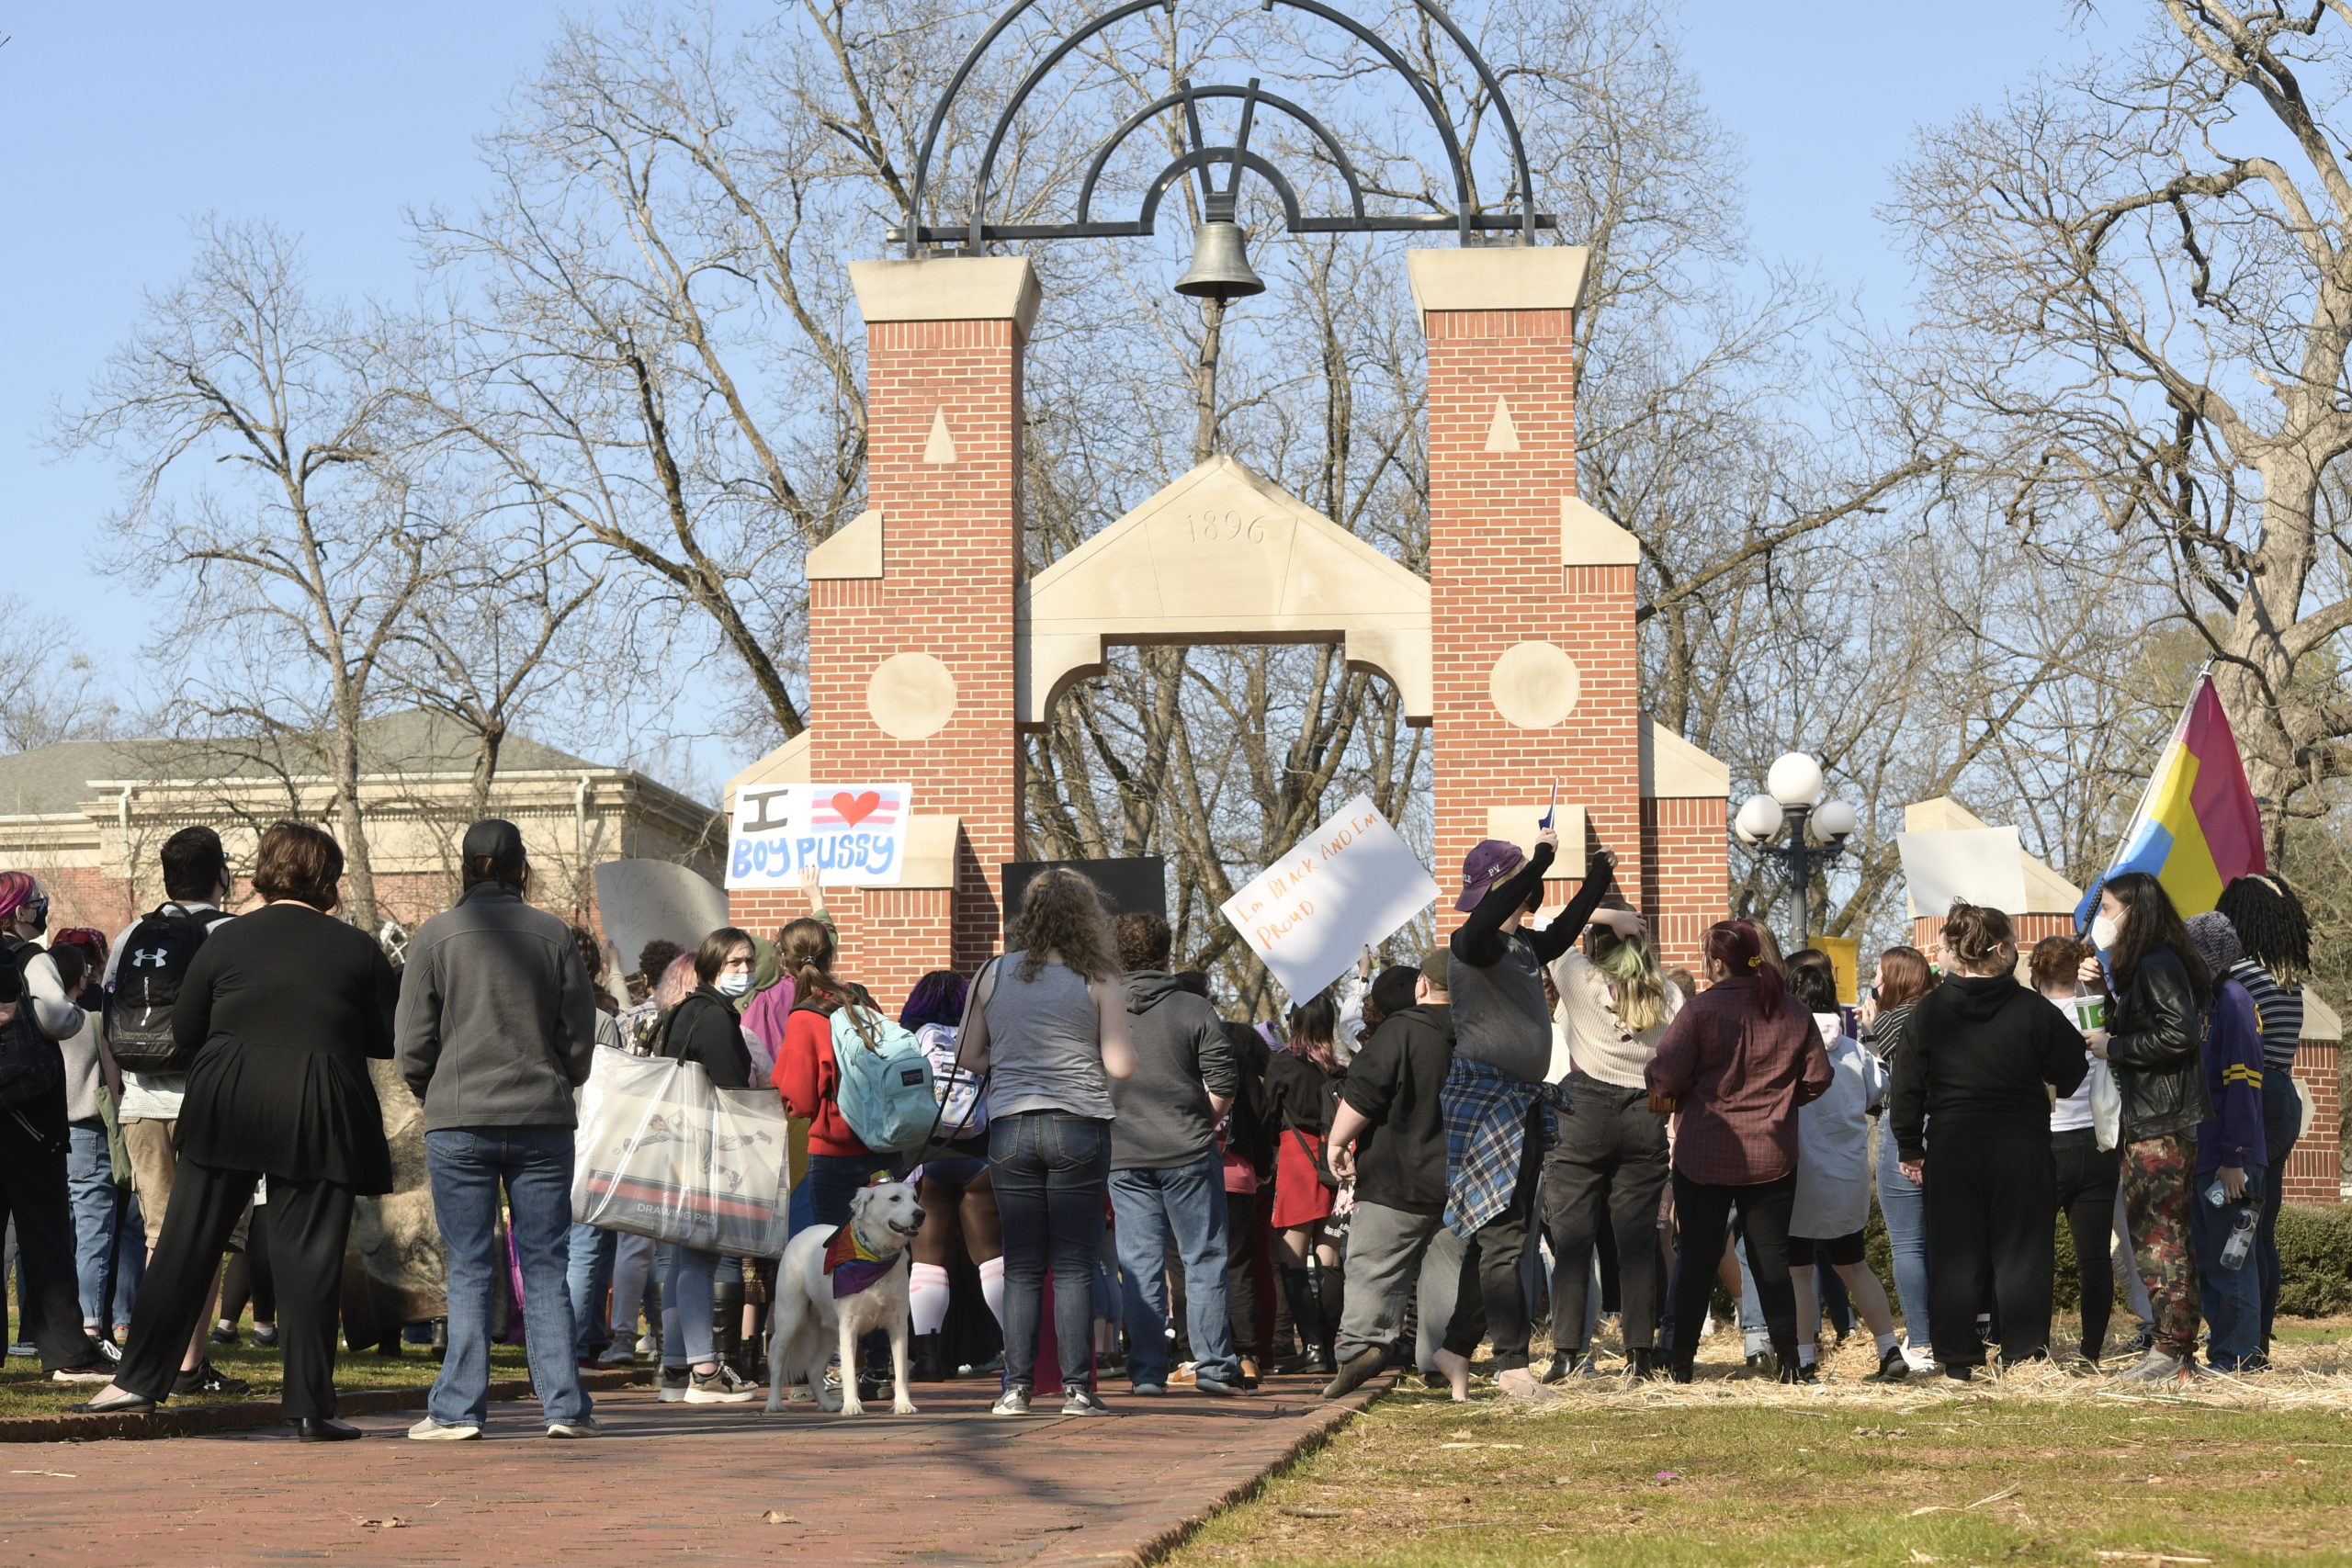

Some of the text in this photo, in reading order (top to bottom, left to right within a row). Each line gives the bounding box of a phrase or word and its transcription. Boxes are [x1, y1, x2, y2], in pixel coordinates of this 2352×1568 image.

[1186, 510, 1267, 544] 1896
[742, 789, 789, 833] I
[731, 833, 895, 879] BOY PUSSY
[1267, 858, 1319, 900] BLACK
[1320, 829, 1352, 861] AND
[637, 1202, 717, 1224] DRAWING PAD
